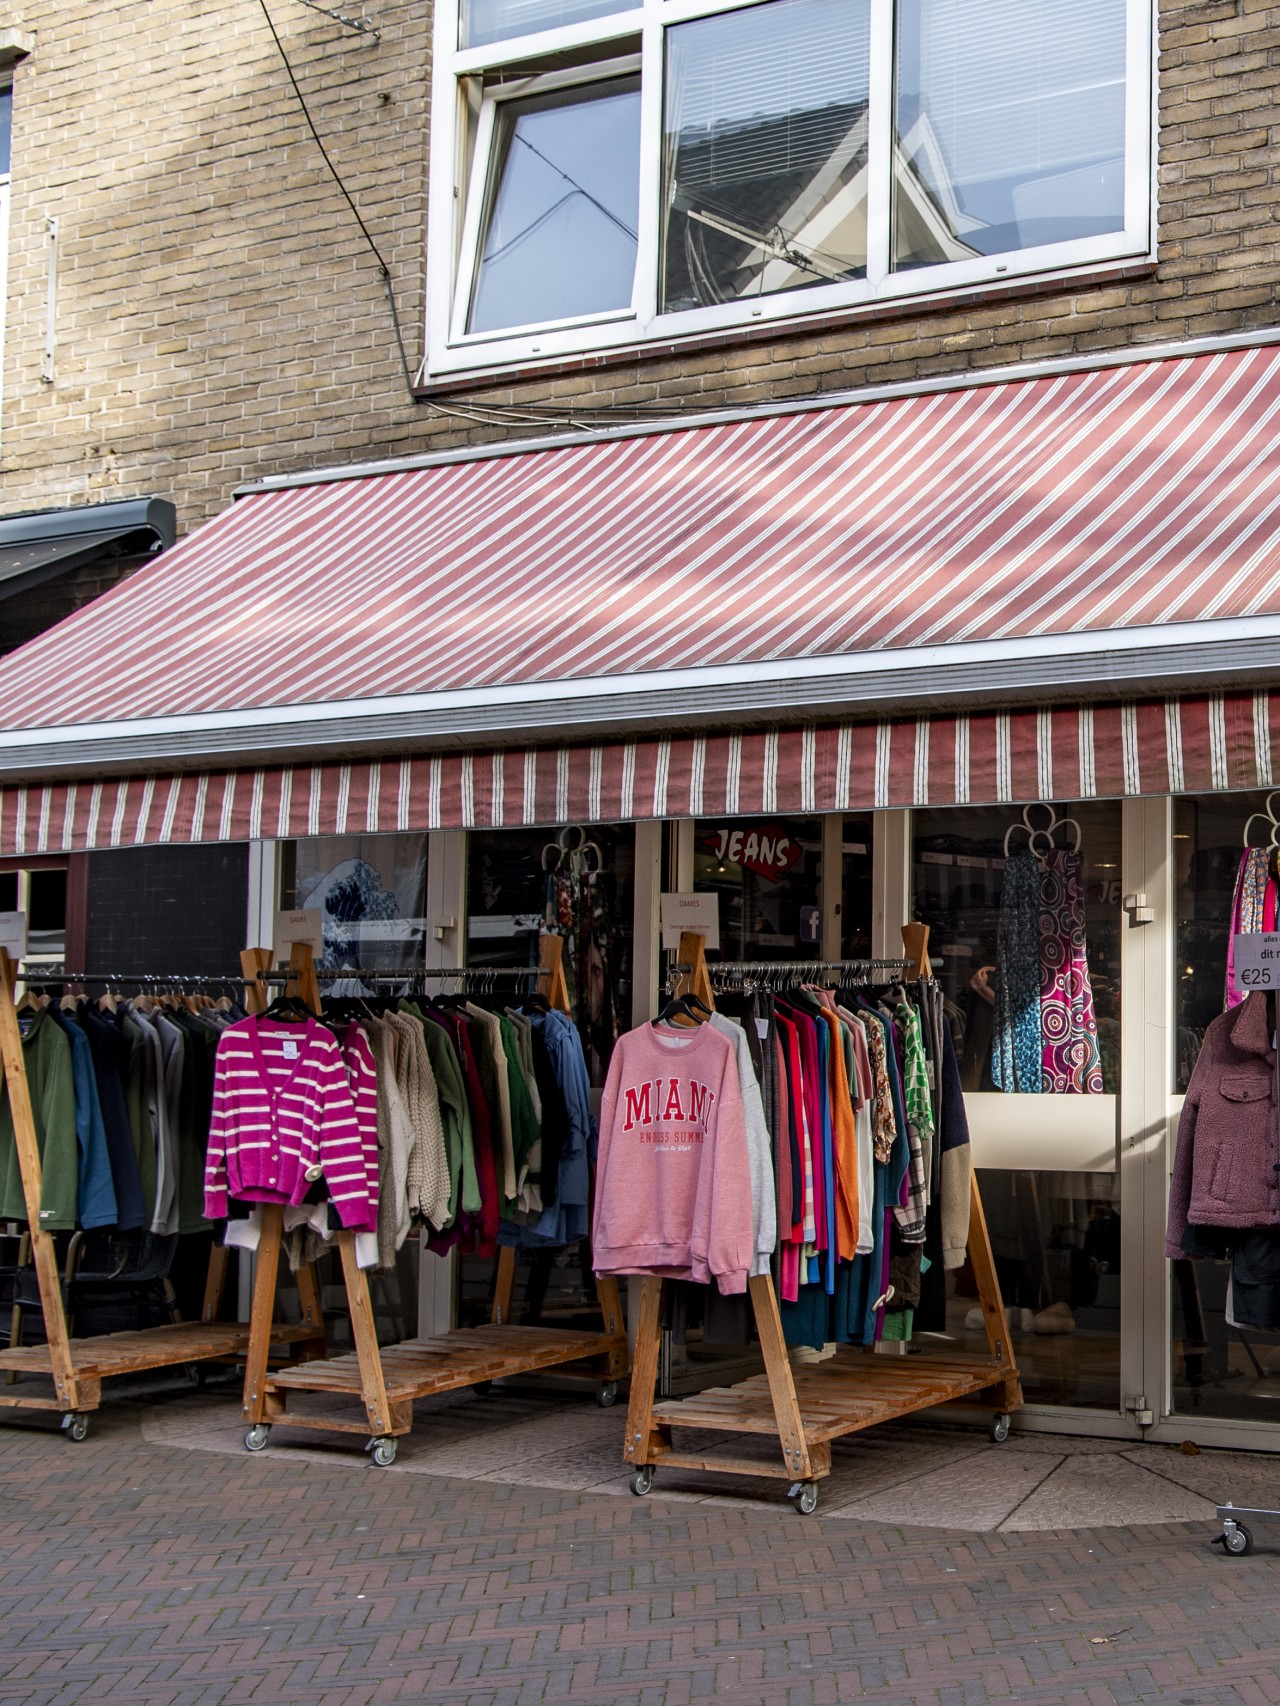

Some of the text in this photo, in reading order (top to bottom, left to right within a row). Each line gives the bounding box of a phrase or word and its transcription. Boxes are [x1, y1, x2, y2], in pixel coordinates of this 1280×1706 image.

[714, 828, 790, 868] JEANS
[679, 900, 700, 908] DAMES
[1263, 935, 1279, 943] alles
[1260, 948, 1275, 960] dit
[1240, 967, 1272, 986] €25
